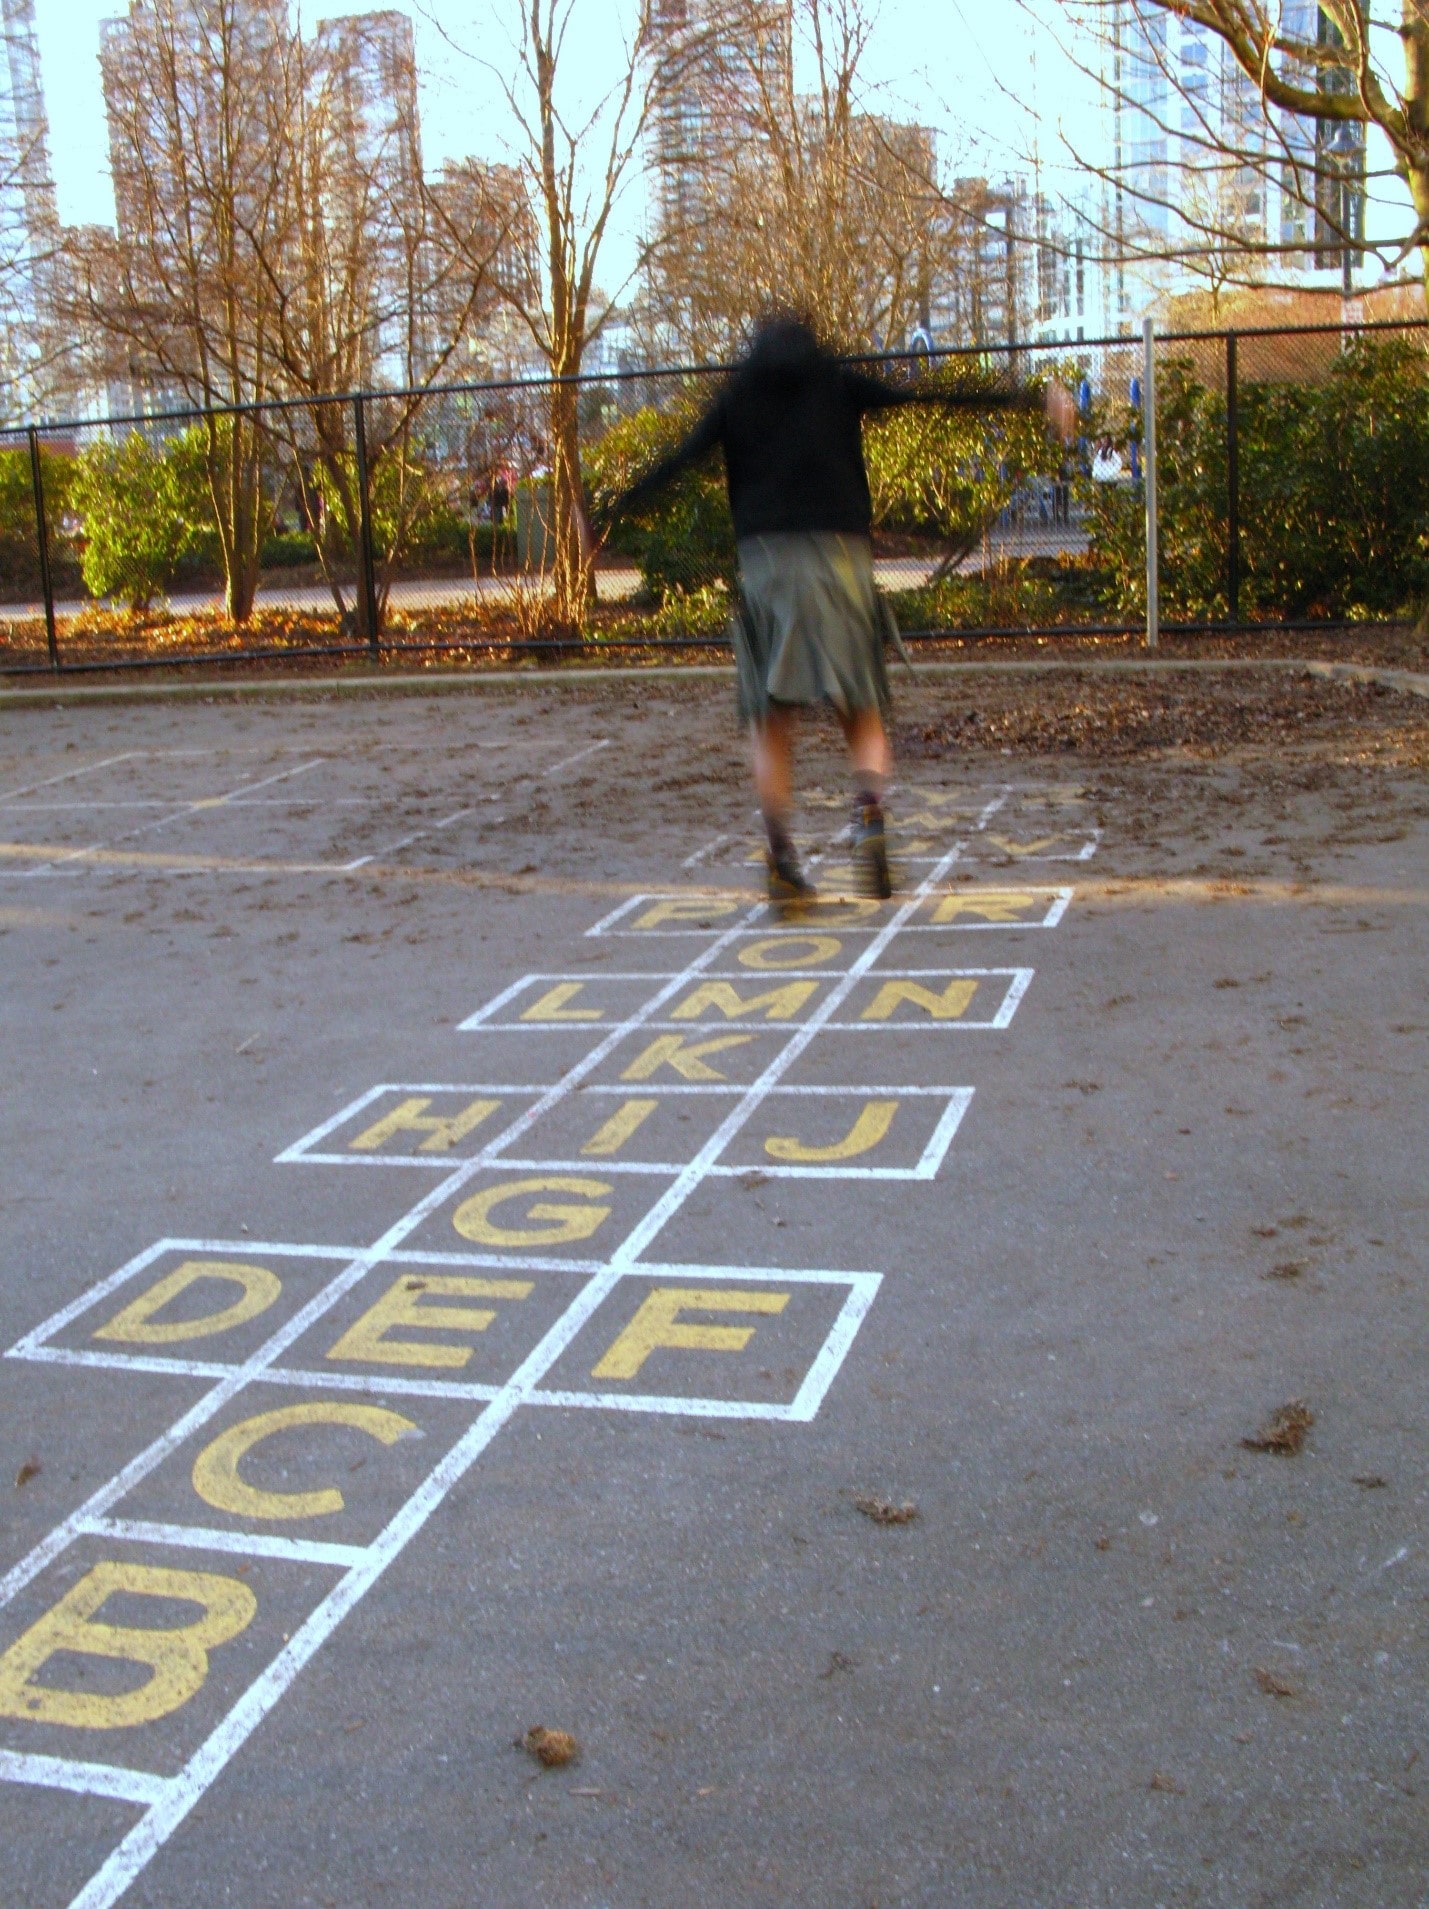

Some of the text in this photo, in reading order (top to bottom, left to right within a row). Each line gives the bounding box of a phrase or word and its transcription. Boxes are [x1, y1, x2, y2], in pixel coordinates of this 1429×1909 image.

[632, 899, 738, 930] P
[928, 894, 1034, 923] R
[738, 935, 842, 969] O
[519, 979, 980, 1020] L M N
[620, 1033, 758, 1080] K
[348, 1097, 899, 1161] H I J
[453, 1177, 612, 1247] G
[92, 1260, 790, 1379] D E F
[192, 1401, 420, 1519] C
[0, 1561, 257, 1730] B
